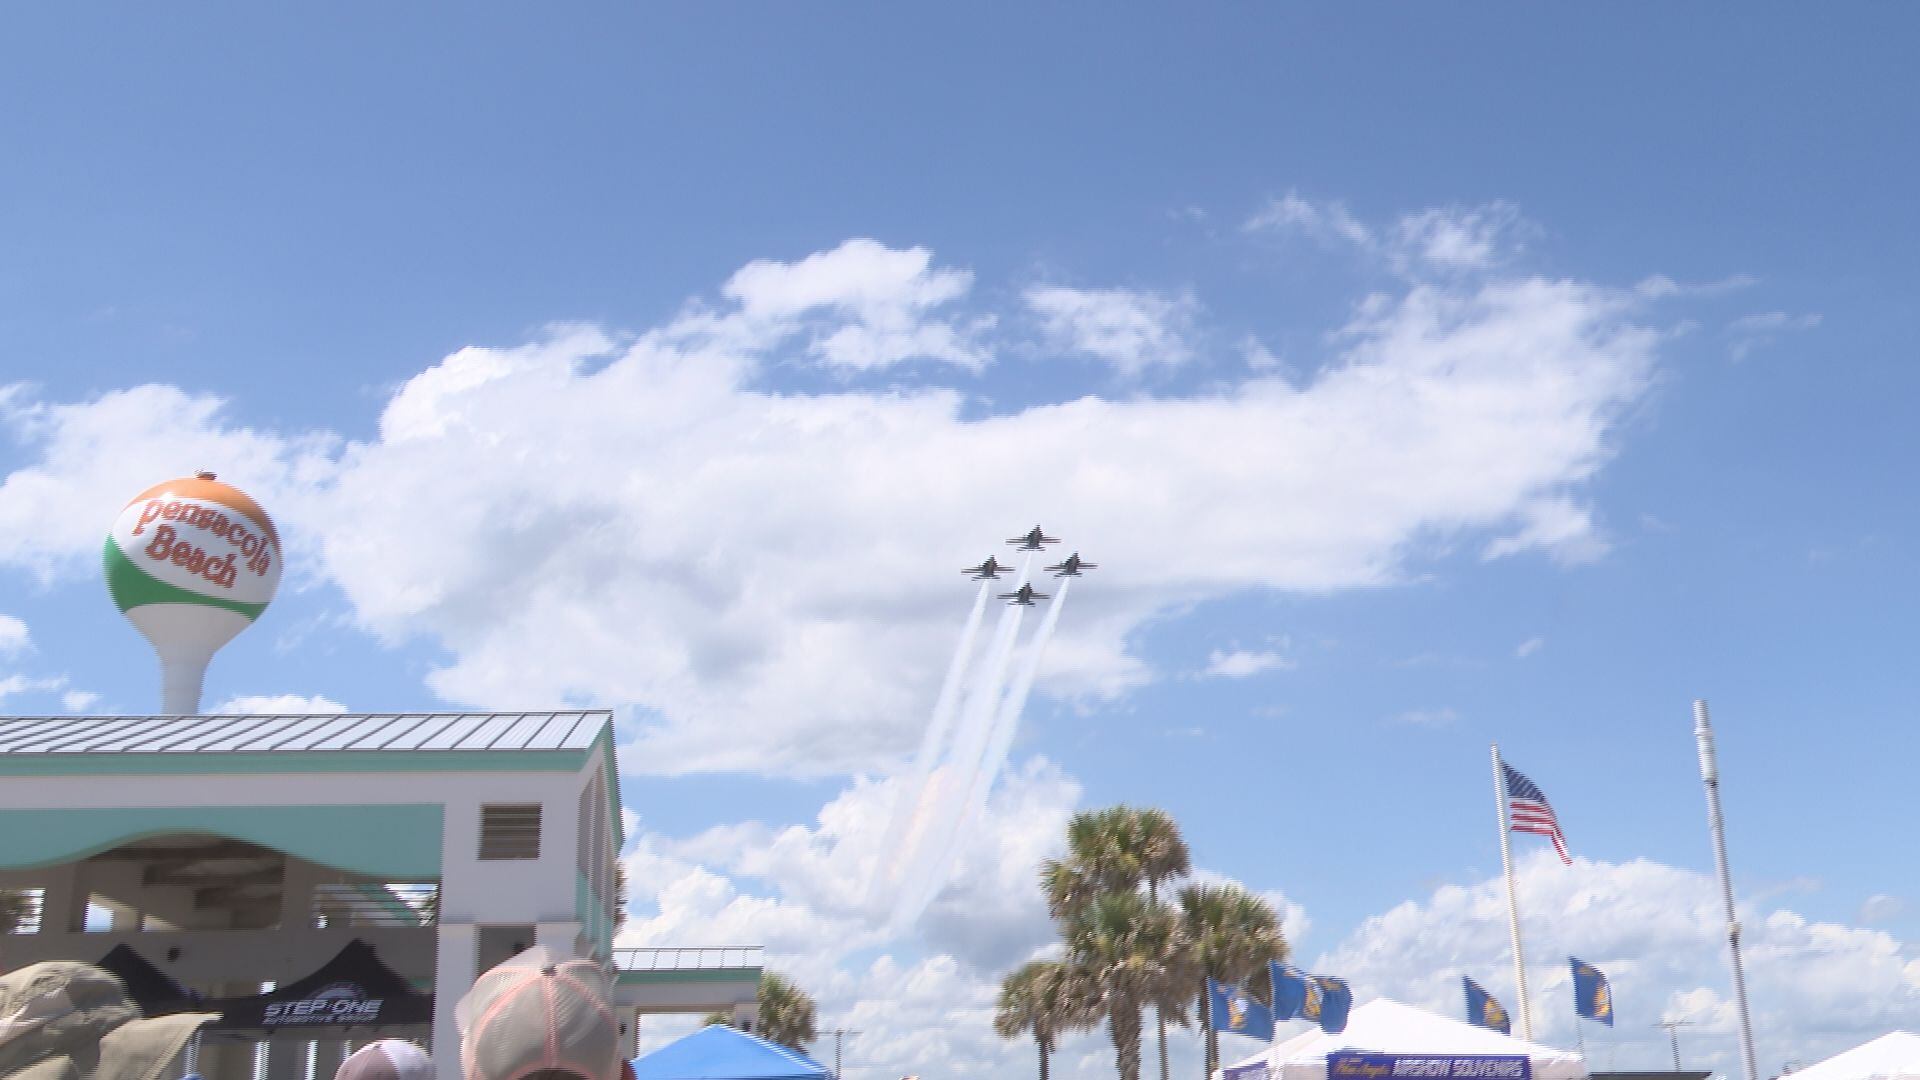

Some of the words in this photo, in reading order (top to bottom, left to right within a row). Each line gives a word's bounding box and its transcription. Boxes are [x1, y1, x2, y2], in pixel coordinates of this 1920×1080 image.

[145, 523, 237, 588] Beach
[1392, 1059, 1451, 1077] AIRSHOW
[1452, 1059, 1523, 1077] SOUVENIRS
